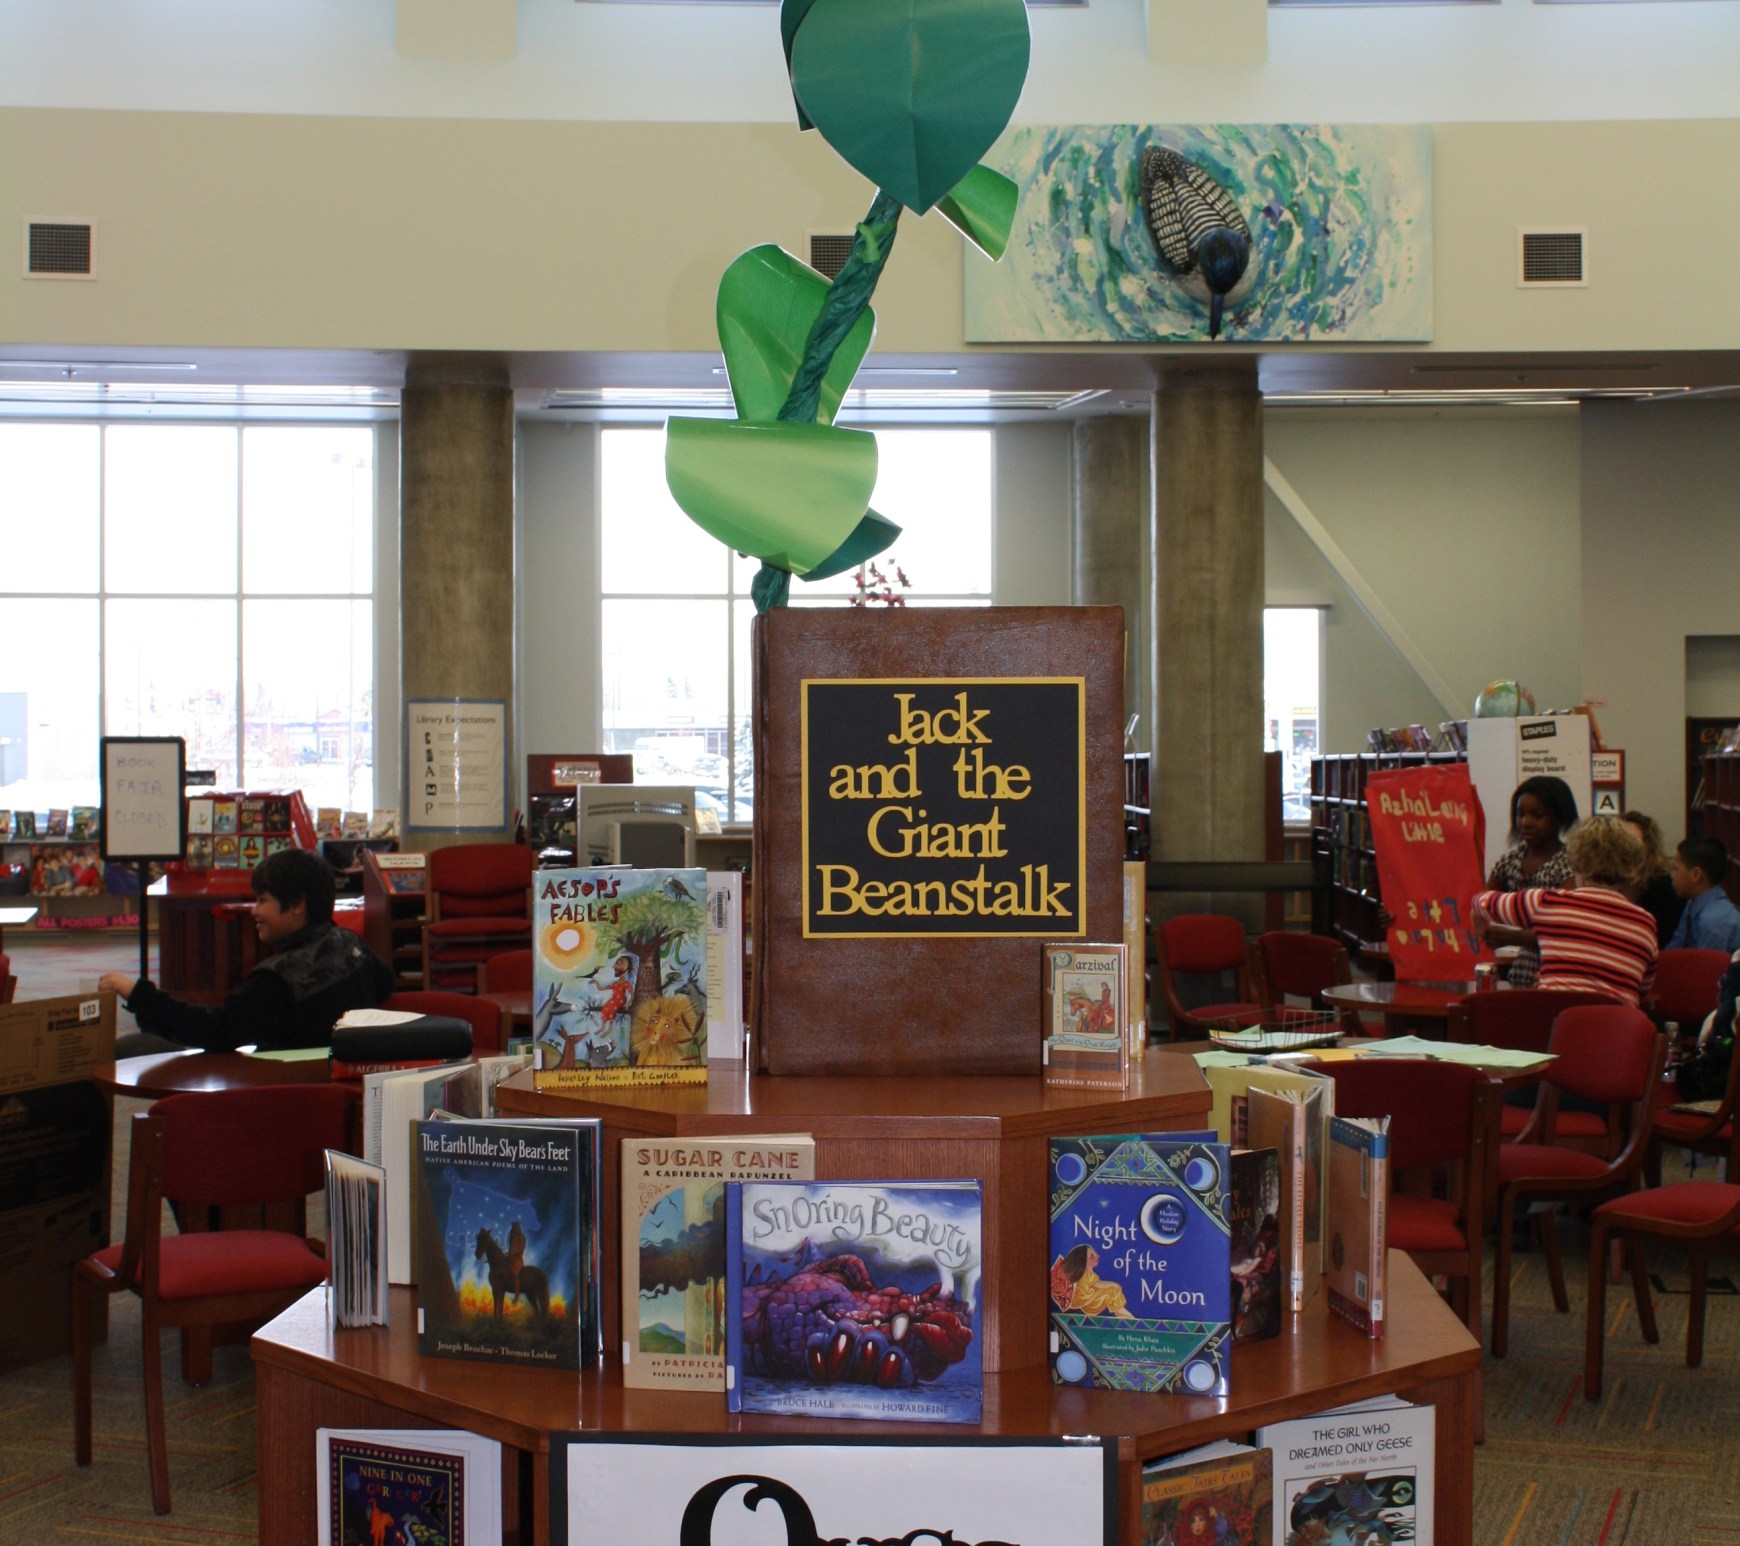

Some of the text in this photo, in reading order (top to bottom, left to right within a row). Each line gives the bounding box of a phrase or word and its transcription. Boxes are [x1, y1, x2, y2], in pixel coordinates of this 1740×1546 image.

[416, 715, 496, 725] Library Expectations
[888, 691, 992, 745] Jack
[1522, 724, 1555, 736] STAPLES
[117, 757, 154, 768] BOOK
[1593, 760, 1617, 768] TION
[828, 747, 1032, 800] and the
[117, 780, 163, 795] FAIR
[1600, 794, 1615, 810] A
[115, 810, 167, 829] CLOSED
[867, 805, 1008, 858] Giant
[541, 874, 621, 899] AESOP'S
[816, 864, 1073, 917] Beanstalk
[550, 902, 622, 924] FABLES
[82, 1004, 96, 1017] 103
[356, 1065, 397, 1073] ALGEBRA
[1047, 1078, 1085, 1086] KATHERINE
[421, 1133, 572, 1162] The Earth Under Sky Bear's Feet
[453, 1159, 489, 1167] AMERICAN
[492, 1161, 516, 1169] POEMS
[637, 1148, 799, 1169] SUGAR CANE
[656, 1170, 724, 1178] CARIBBEAN
[730, 1172, 792, 1180] RAPUNZEL
[1074, 1214, 1137, 1249] Night
[1114, 1248, 1167, 1277] of the
[1141, 1279, 1205, 1306] Moon
[438, 1341, 557, 1359] Joseph Bruchac Thomas Locker
[664, 1360, 723, 1368] PATRICIA
[777, 1398, 834, 1409] BRUCE HALE
[882, 1403, 924, 1412] HOWARD
[926, 1404, 949, 1414] FINE
[1312, 1423, 1390, 1441] THE GIRL WHO
[1289, 1436, 1413, 1460] DREAMED ONLY GEESE
[360, 1466, 432, 1486] NINE IN ONE
